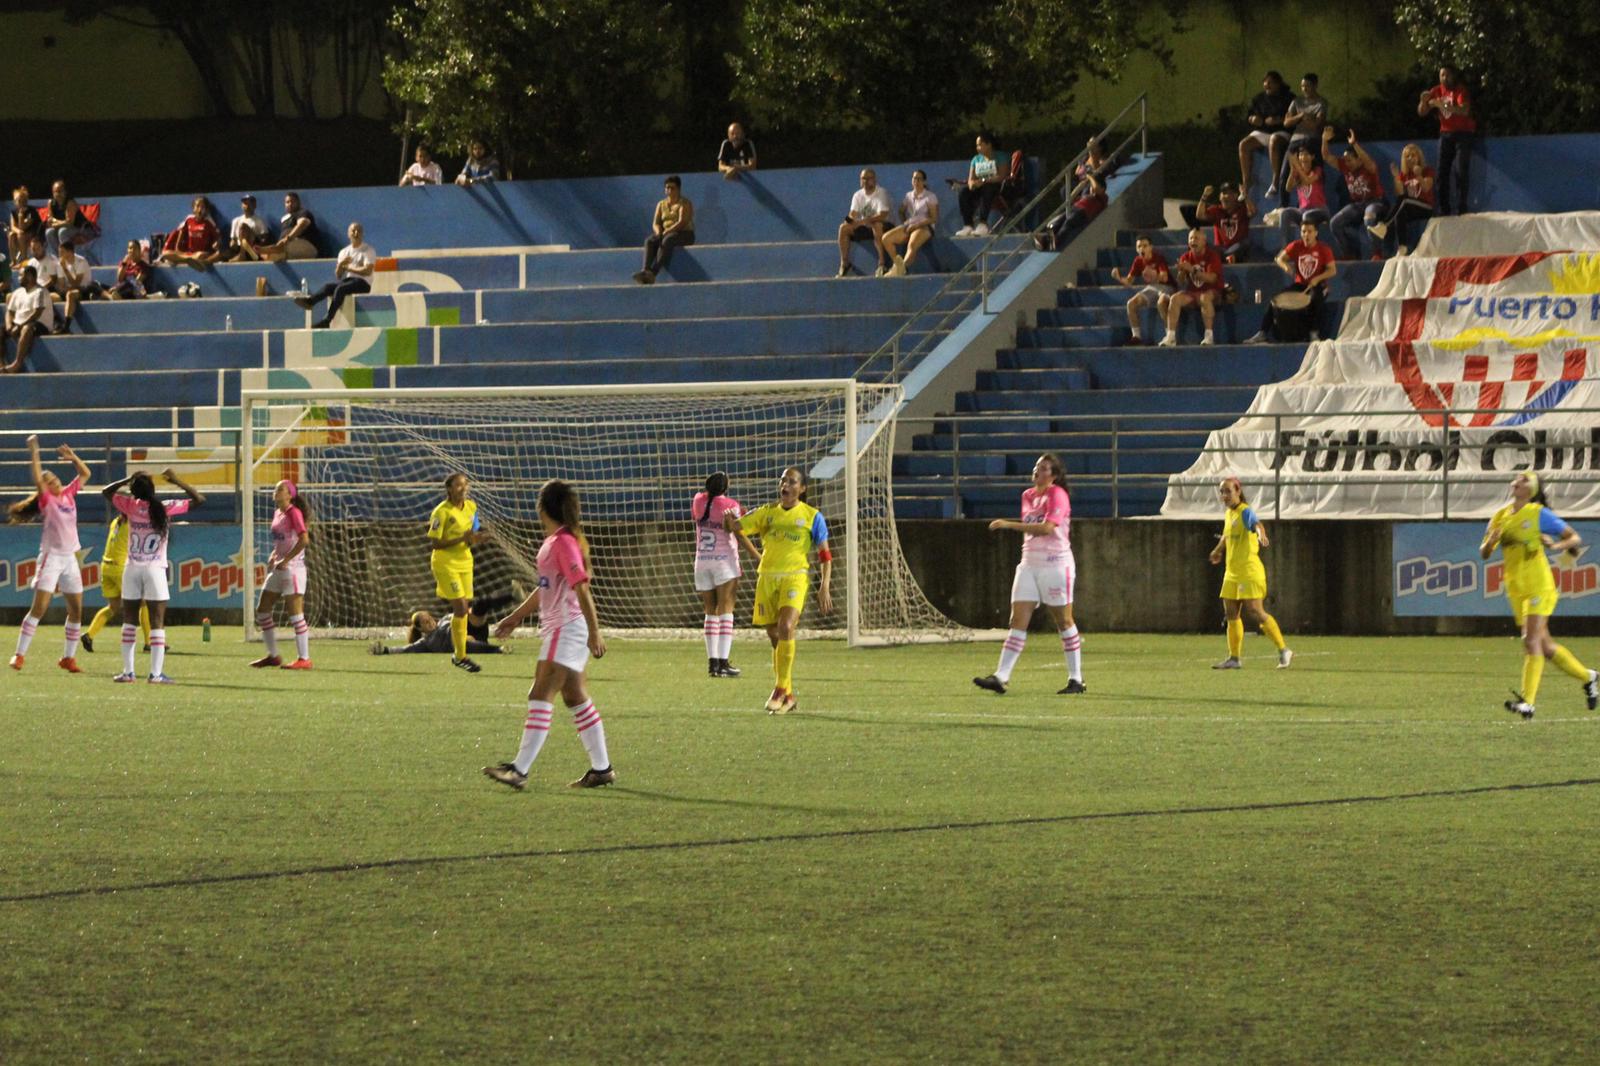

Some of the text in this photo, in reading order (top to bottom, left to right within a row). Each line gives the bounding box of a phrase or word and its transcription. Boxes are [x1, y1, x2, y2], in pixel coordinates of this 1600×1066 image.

[1481, 427, 1600, 471] Clu
[130, 532, 162, 555] 10
[699, 528, 717, 552] 2
[1397, 556, 1478, 597] Pan
